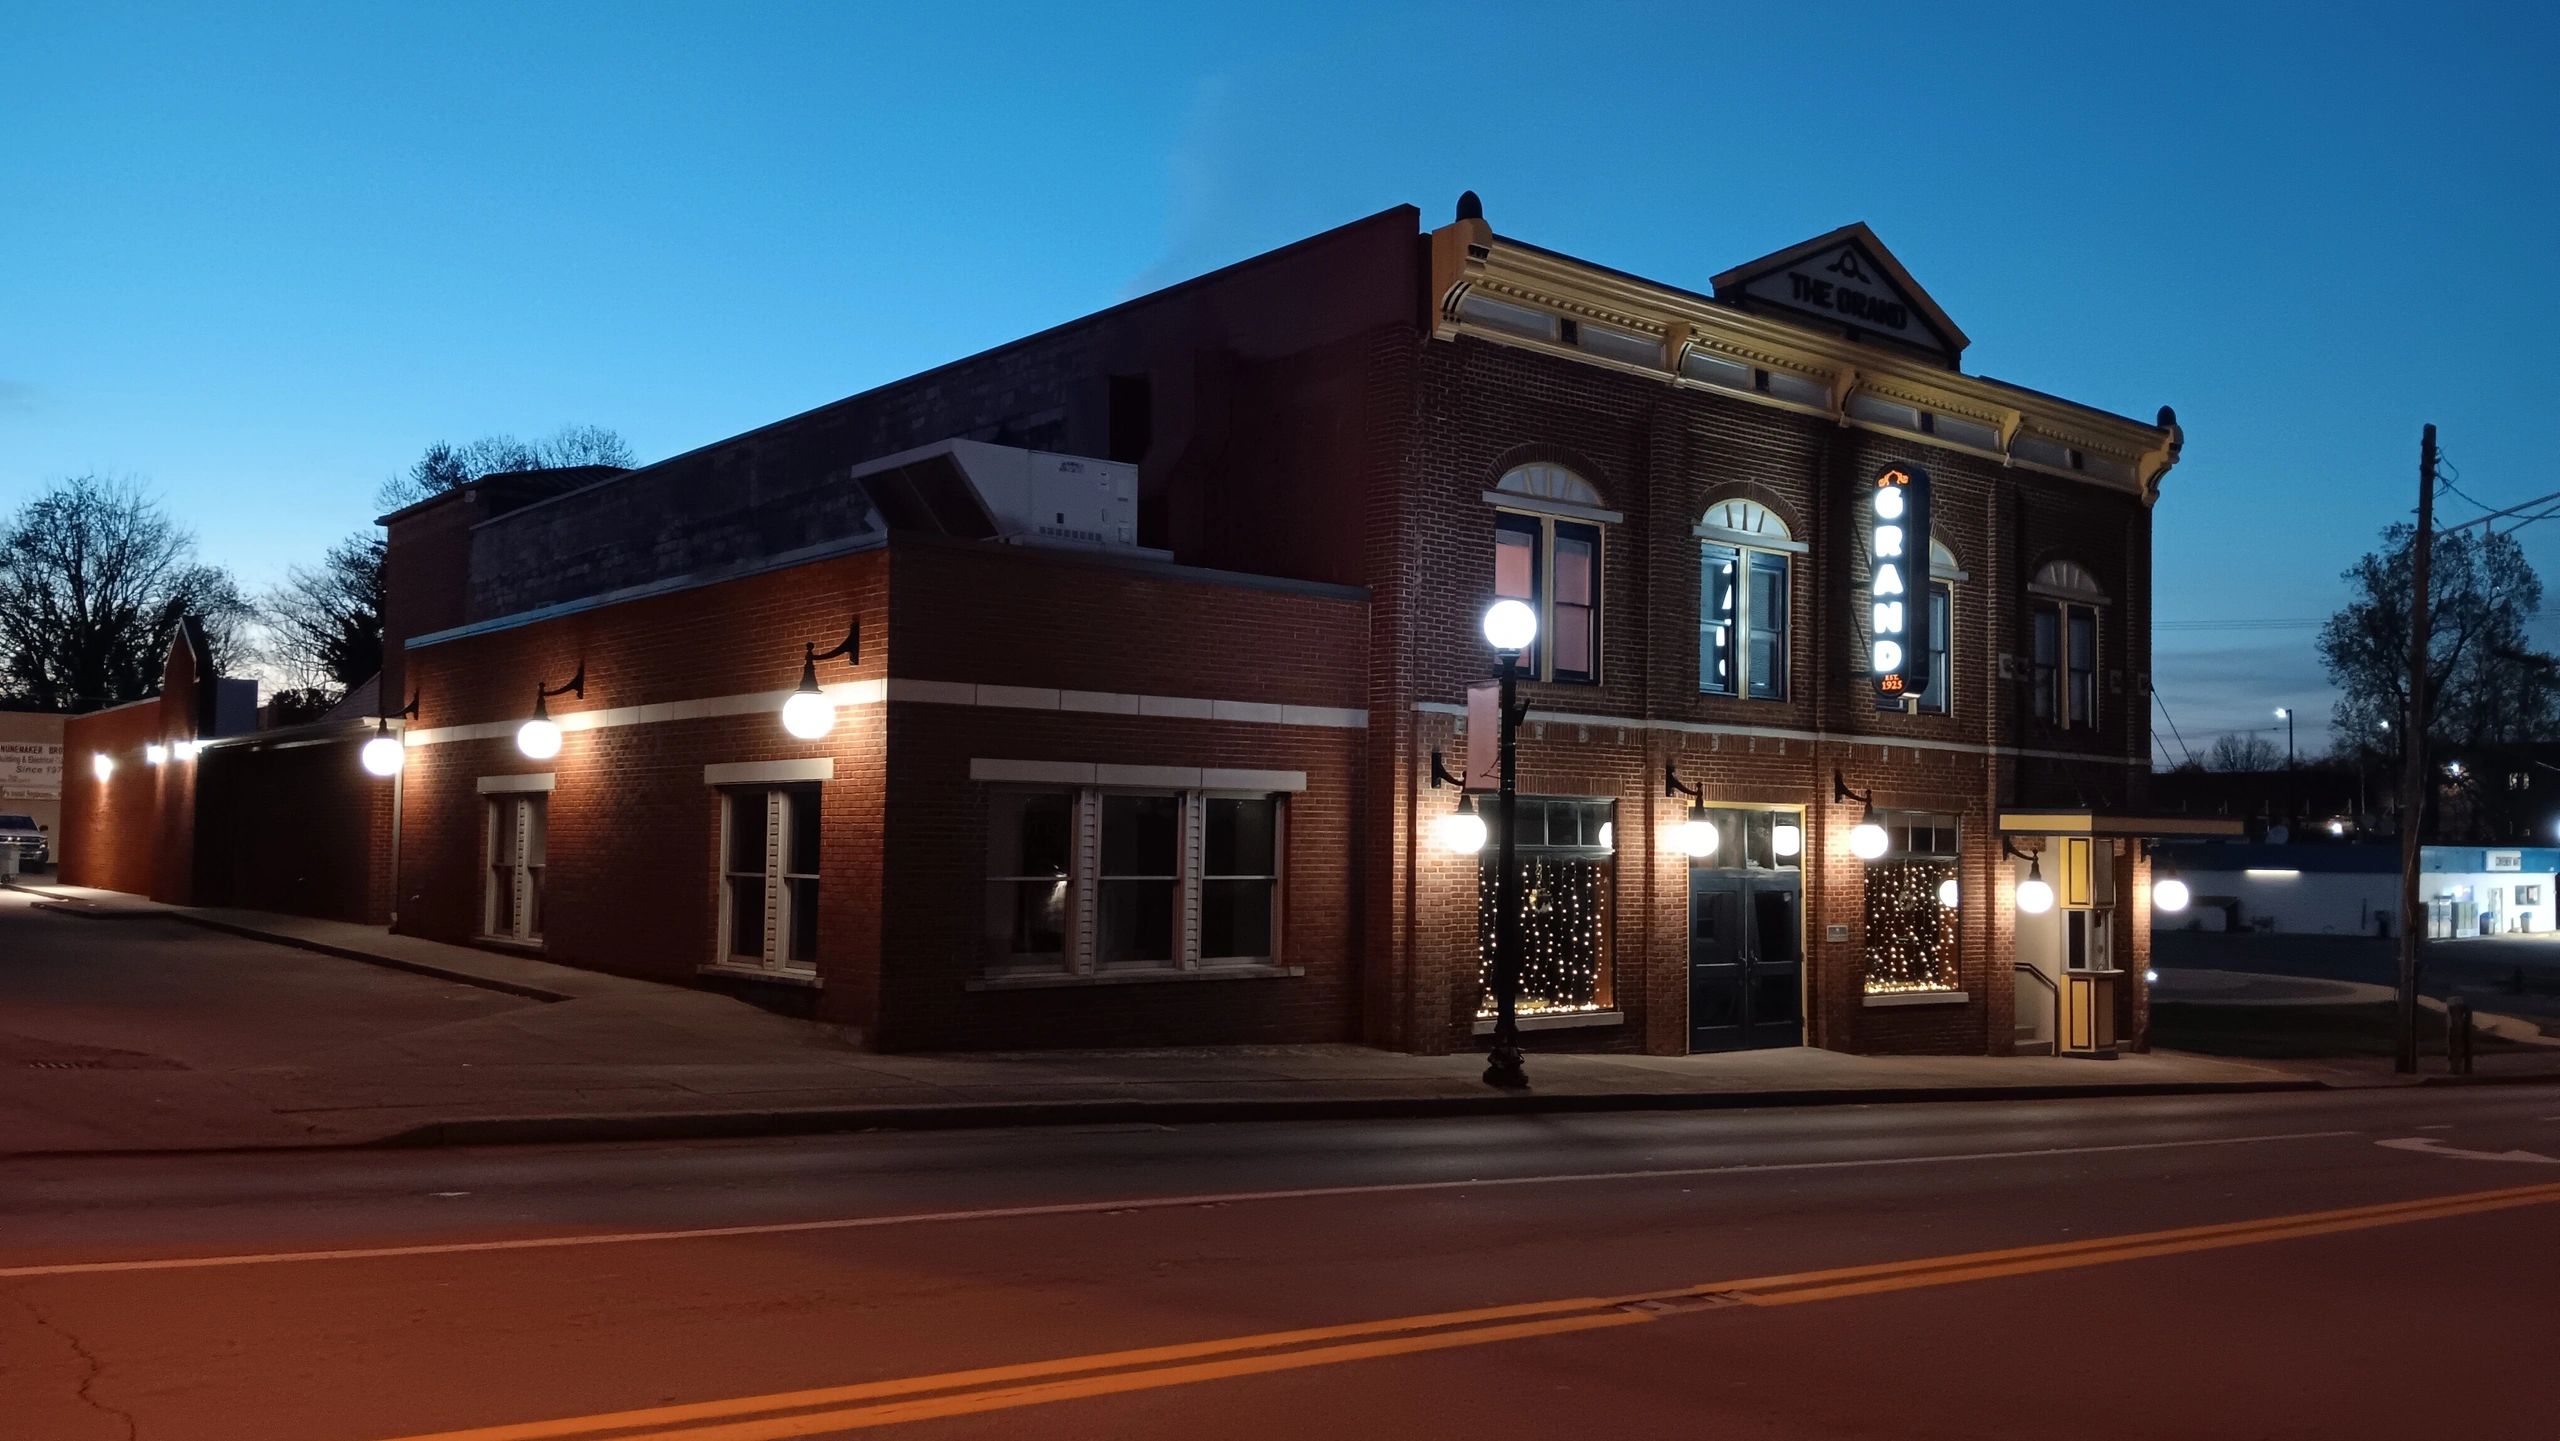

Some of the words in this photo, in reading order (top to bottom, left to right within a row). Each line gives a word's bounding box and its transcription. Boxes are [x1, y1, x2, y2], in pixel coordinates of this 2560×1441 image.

[1788, 271, 1834, 309] THE
[1836, 286, 1908, 330] GRAND
[1873, 486, 1904, 672] GRAND
[1881, 680, 1903, 690] 1925
[15, 765, 43, 774] Since
